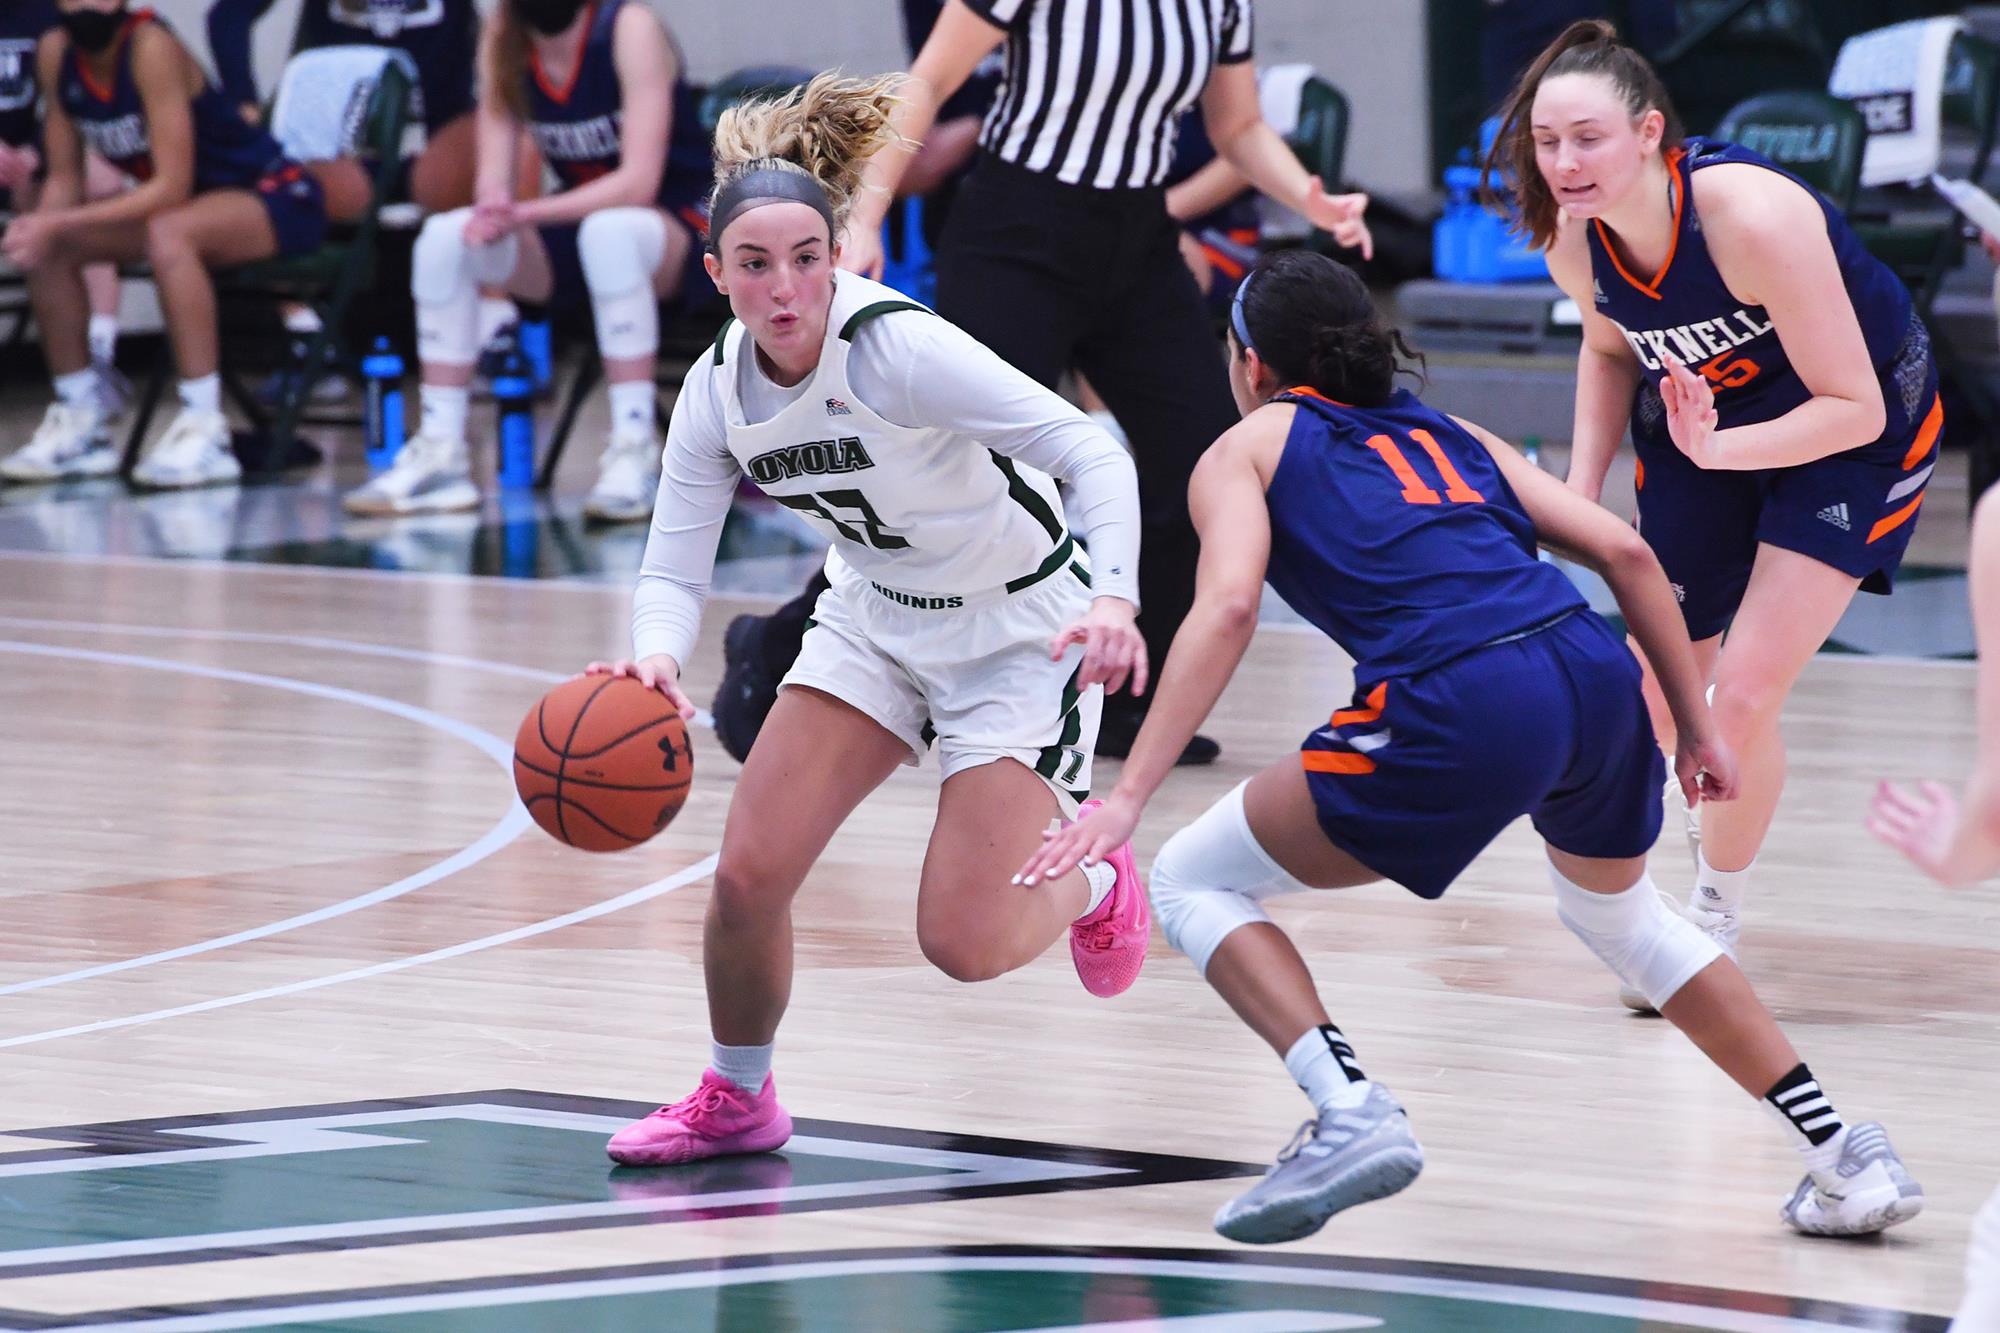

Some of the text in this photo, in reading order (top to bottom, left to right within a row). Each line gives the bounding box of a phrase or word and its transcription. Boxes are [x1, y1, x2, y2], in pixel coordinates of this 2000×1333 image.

[1610, 310, 1774, 370] CKNELL
[748, 436, 876, 484] OYOLA
[1365, 428, 1485, 504] 11
[871, 580, 963, 610] HOUNDS
